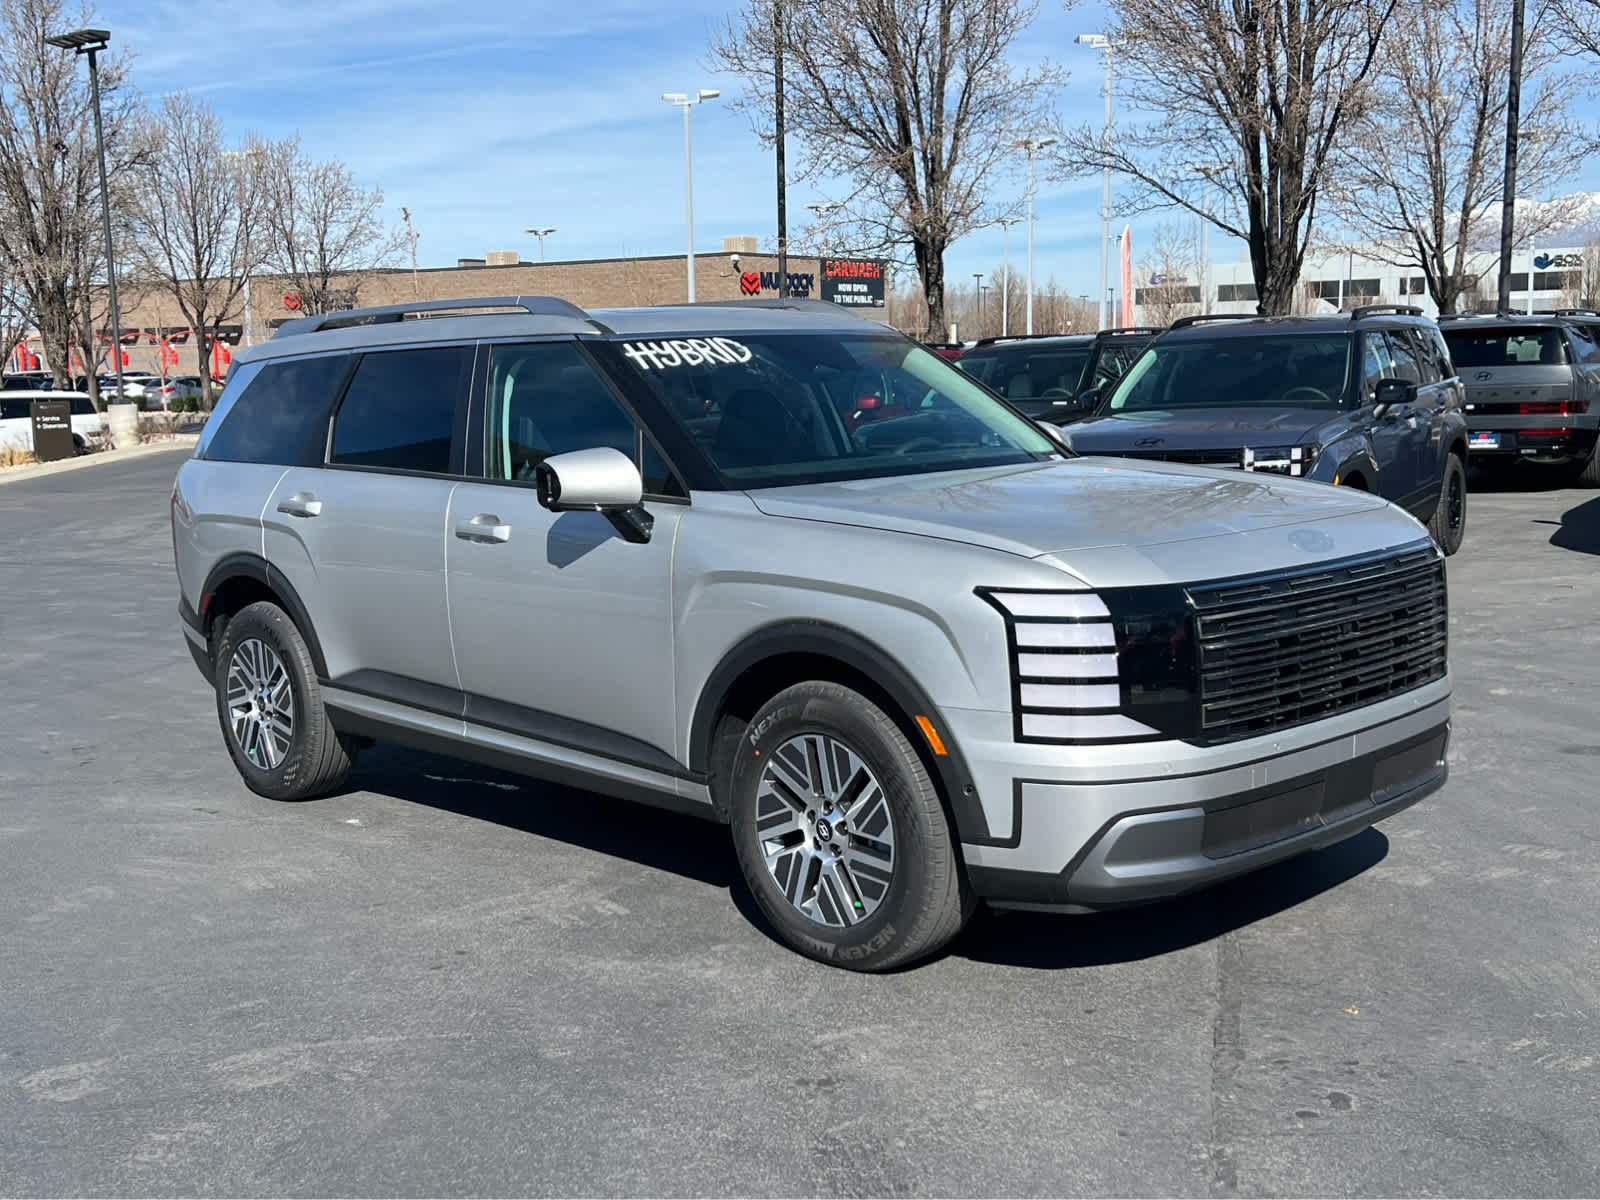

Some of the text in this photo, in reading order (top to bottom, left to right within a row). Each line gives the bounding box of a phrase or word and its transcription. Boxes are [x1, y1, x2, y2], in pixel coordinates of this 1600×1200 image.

[760, 272, 814, 290] MUDOCK
[838, 283, 868, 292] NOW OPEN
[833, 294, 842, 304] TO
[842, 294, 853, 304] THE
[853, 295, 873, 304] PUBLIC
[623, 337, 752, 369] HYBRID
